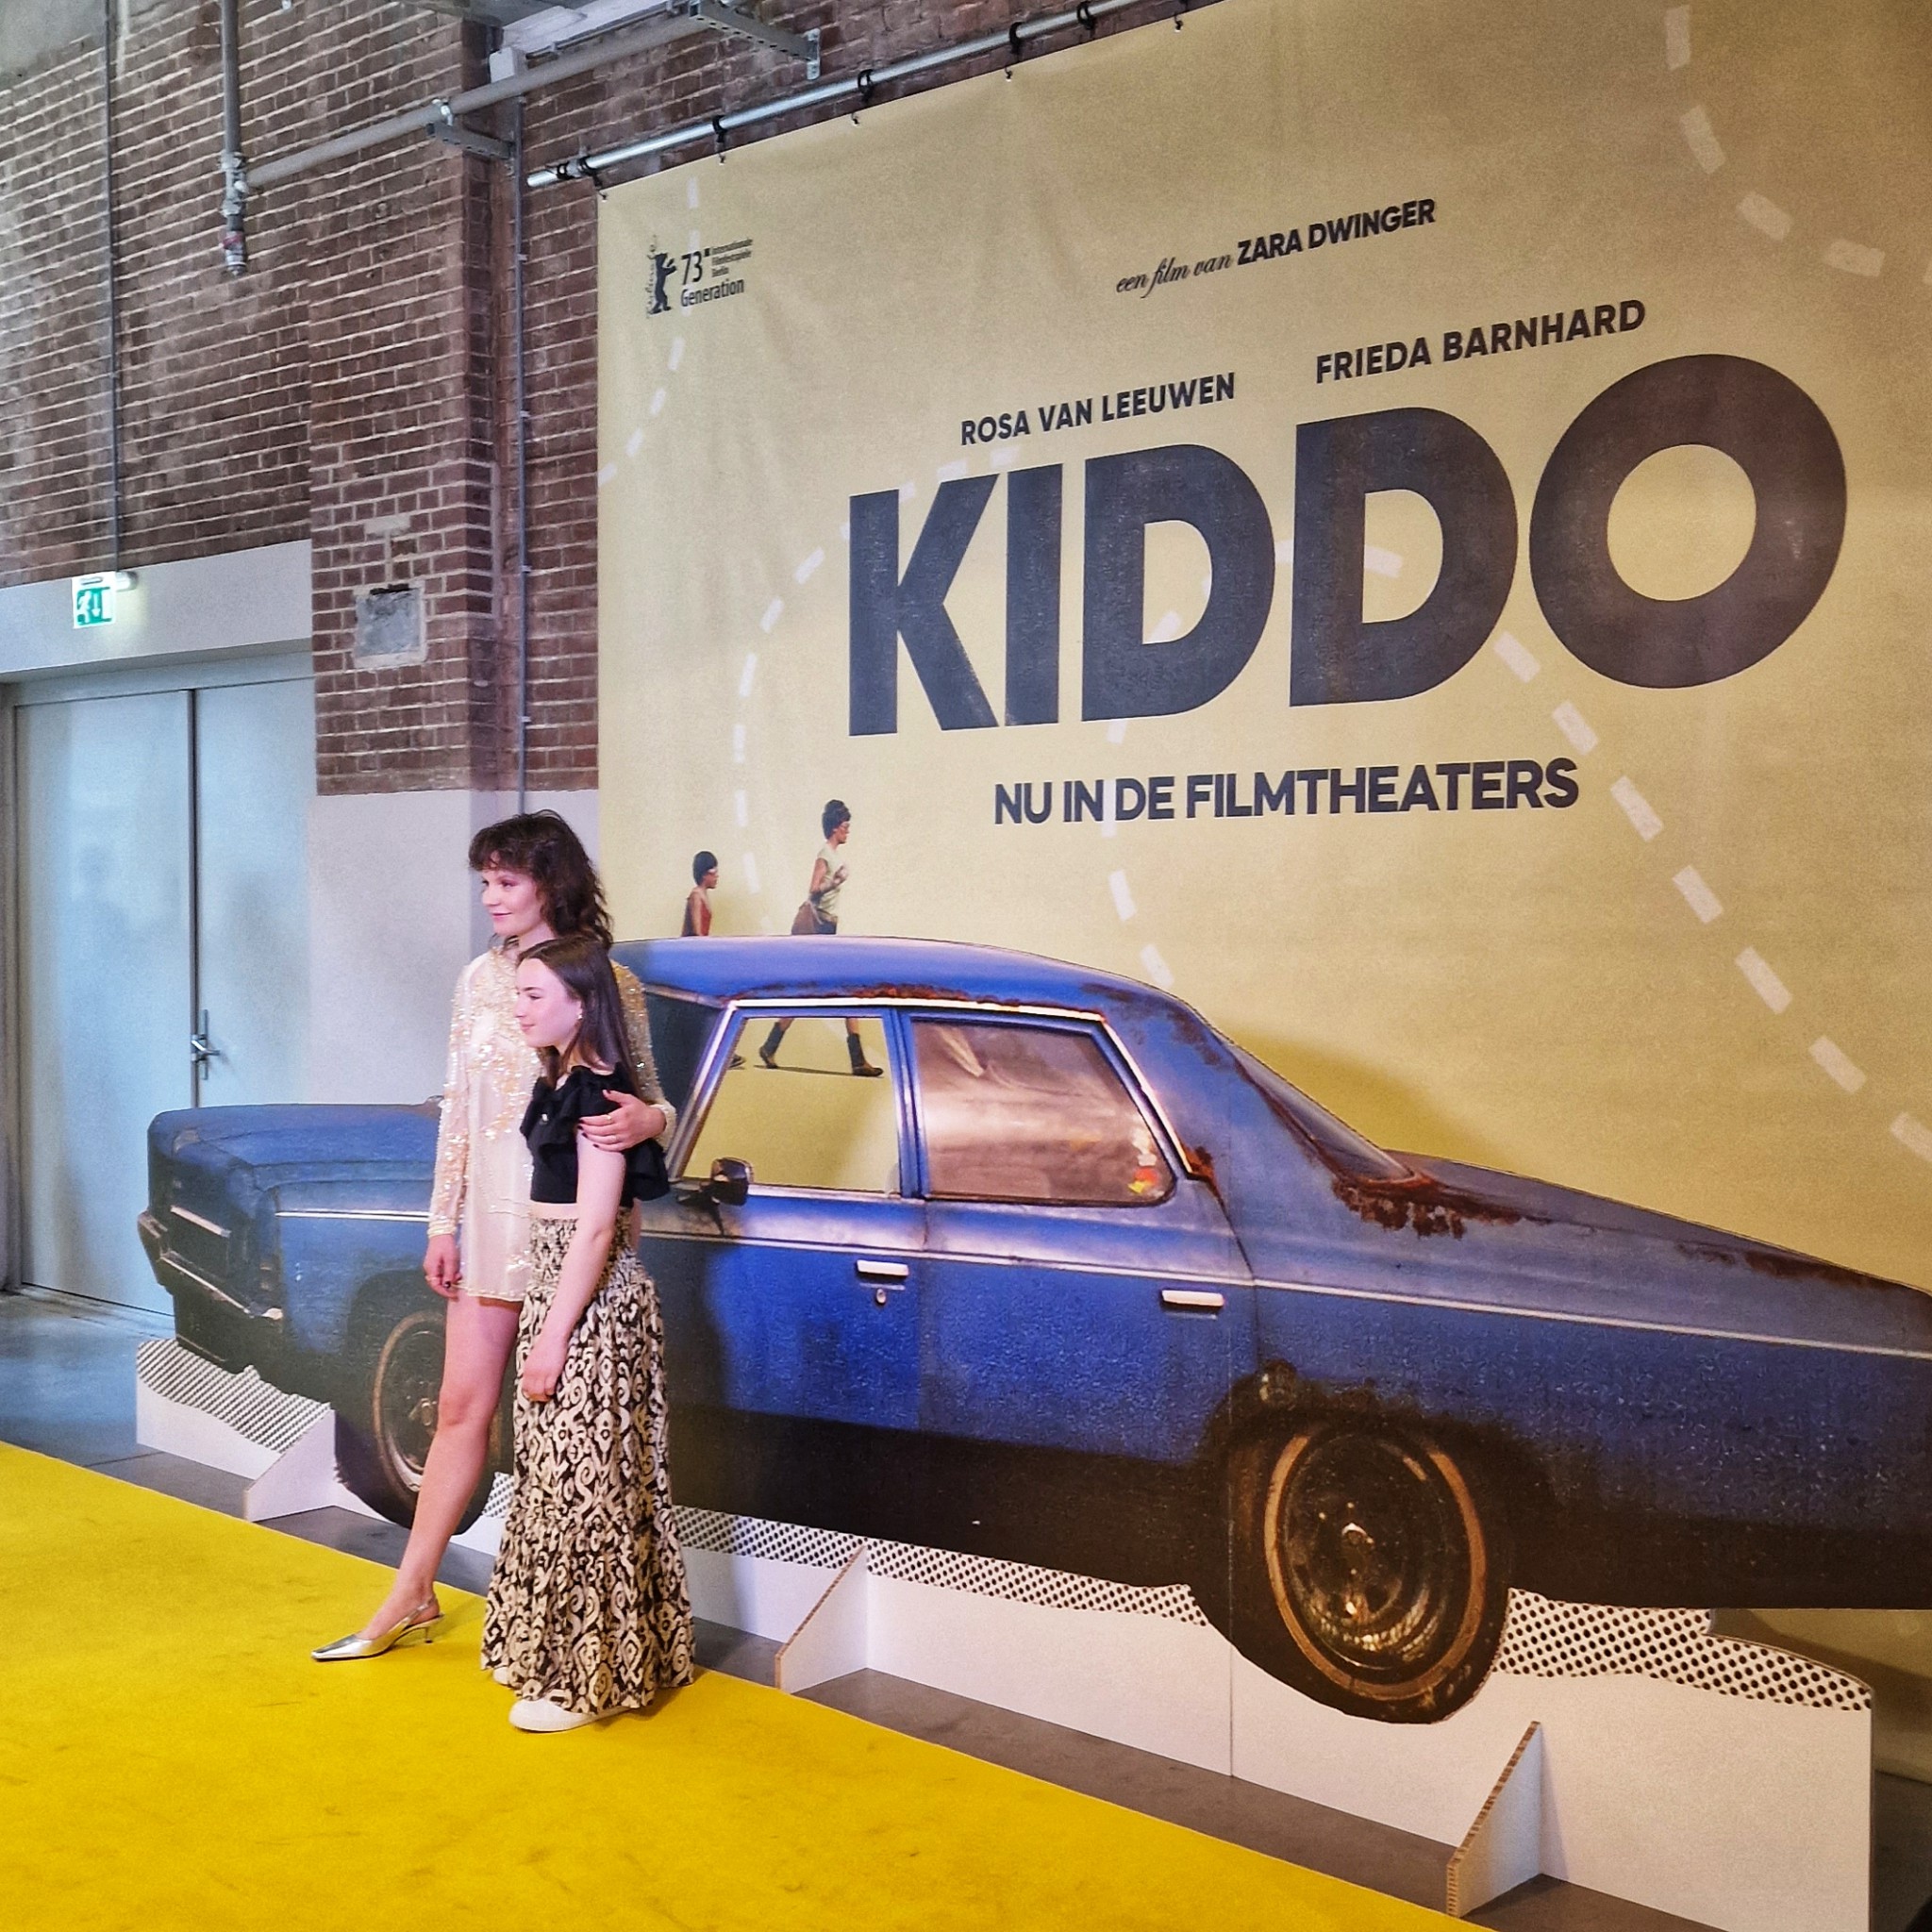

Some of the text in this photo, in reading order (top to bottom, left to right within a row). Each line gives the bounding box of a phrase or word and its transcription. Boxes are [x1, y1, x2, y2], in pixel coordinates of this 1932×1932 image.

[1116, 199, 1435, 298] een film van ZARA DWINGER
[681, 278, 744, 307] Generation
[1317, 300, 1645, 383] FRIEDA BARNHARD
[960, 373, 1235, 445] ROSA VAN LEEUWEN
[850, 354, 1848, 736] KIDDO
[995, 758, 1579, 824] NU IN DE FILMTHEATERS
